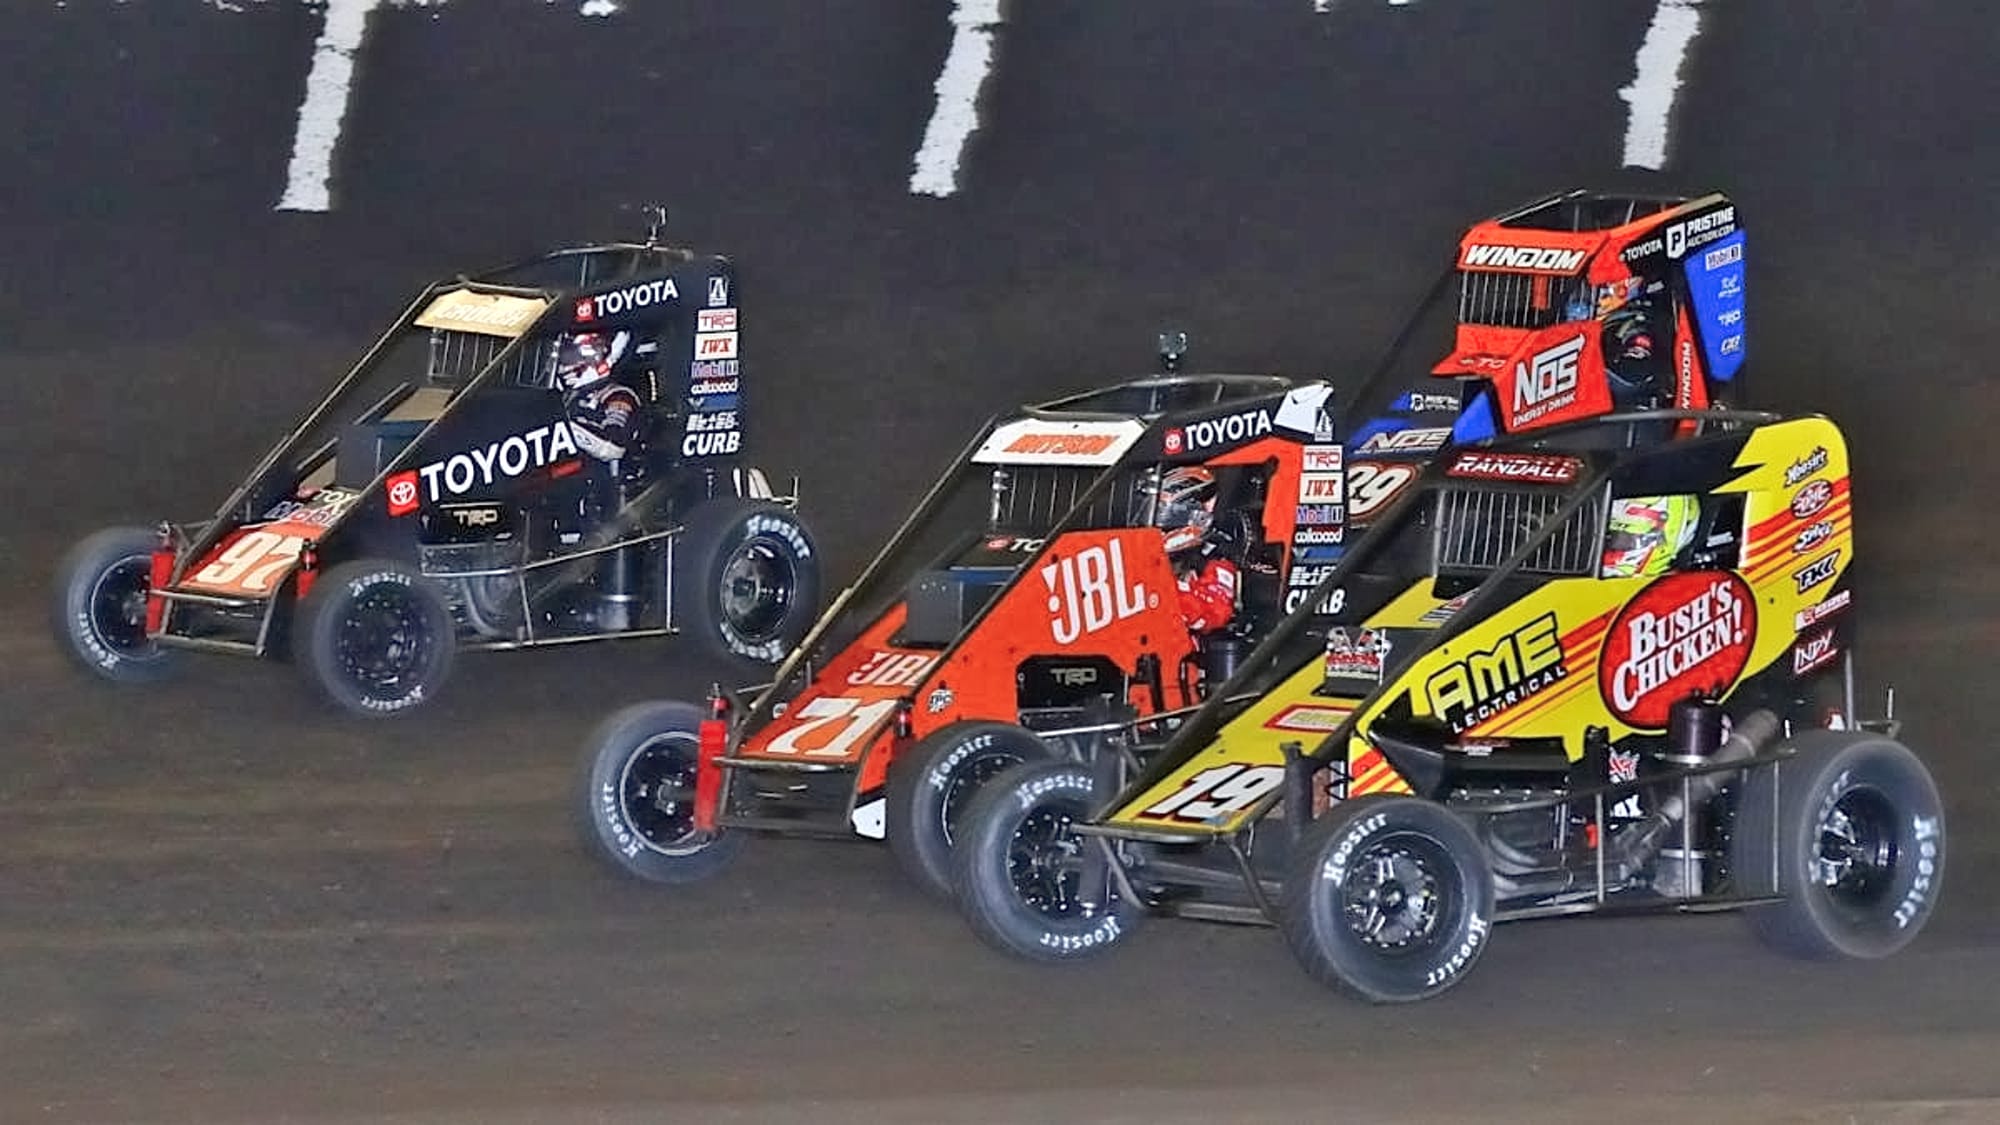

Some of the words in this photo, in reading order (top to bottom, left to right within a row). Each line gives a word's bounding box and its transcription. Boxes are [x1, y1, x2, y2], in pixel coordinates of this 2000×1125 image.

[1686, 206, 1734, 236] PRISTINE
[1464, 245, 1585, 270] WINDOM
[1625, 239, 1663, 261] TOYOTA
[595, 279, 679, 317] TOYOTA
[701, 314, 736, 329] TRD
[701, 337, 733, 354] IWX
[1513, 334, 1586, 413] NOS
[1513, 403, 1547, 428] ENERGY
[1547, 391, 1576, 413] DRINK
[683, 431, 741, 456] CURB
[1185, 409, 1272, 450] TOYOTA
[420, 421, 577, 502] TOYOTA
[1305, 450, 1341, 468] TRD
[1454, 456, 1571, 478] RANDALL
[1305, 479, 1338, 497] IWX
[454, 509, 498, 525] TRD
[196, 531, 305, 589] 97
[1041, 538, 1145, 645] JBL
[1628, 580, 1732, 666] BUSH'S
[1612, 598, 1743, 712] CHICKEN!
[1050, 668, 1098, 686] TRD
[1452, 664, 1568, 735] LECTRICAL
[766, 697, 898, 757] 71
[929, 735, 993, 791] Hoosier
[1145, 764, 1286, 819] 19
[1323, 803, 1387, 888] Hoosier
[1427, 912, 1488, 986] Hoosier
